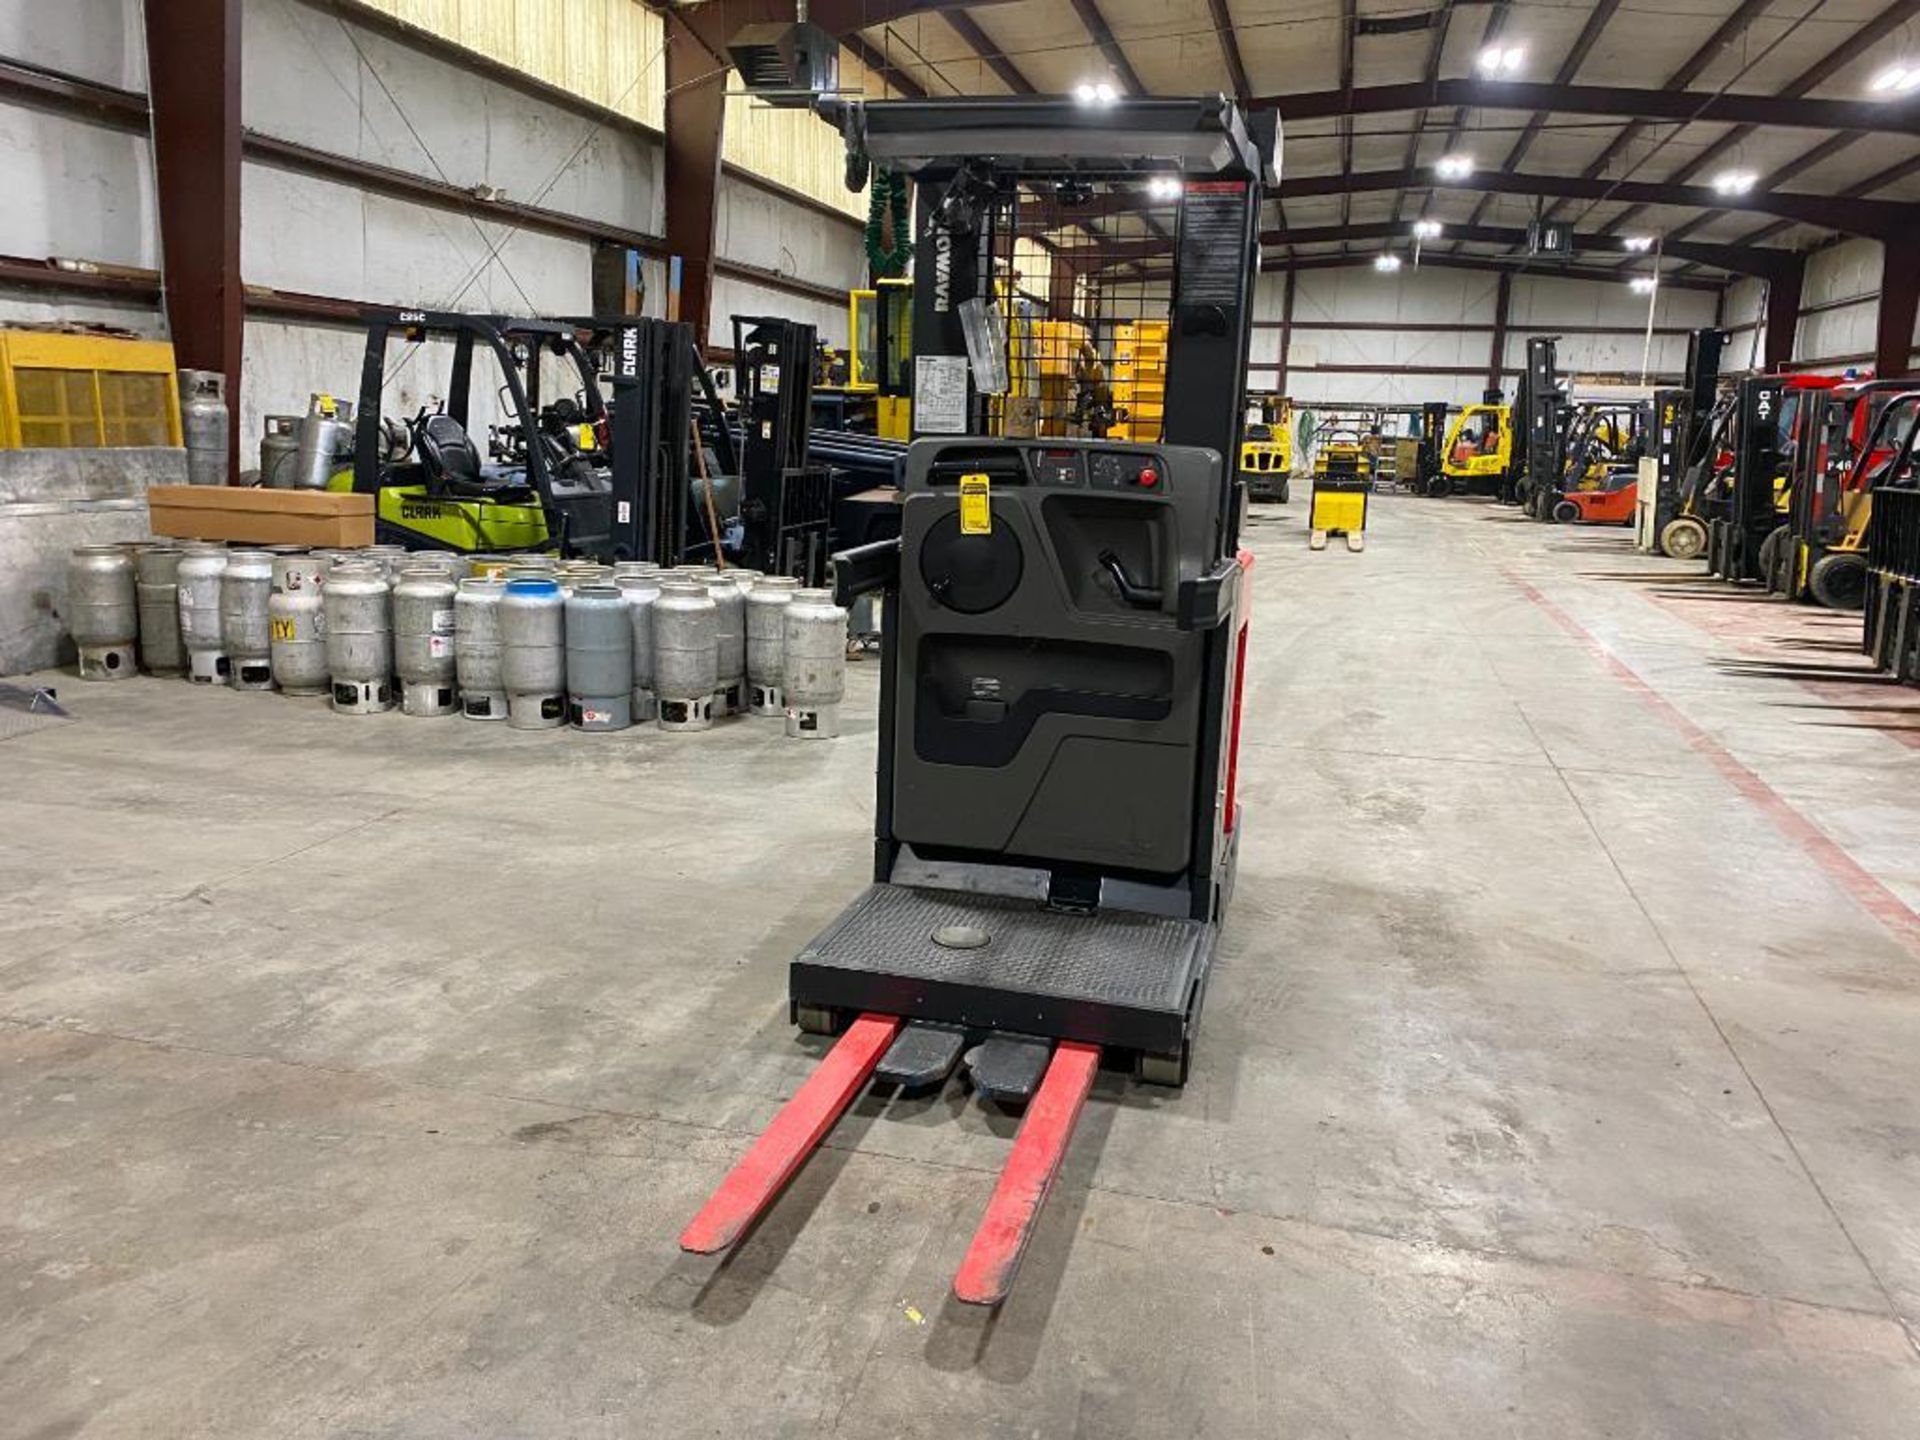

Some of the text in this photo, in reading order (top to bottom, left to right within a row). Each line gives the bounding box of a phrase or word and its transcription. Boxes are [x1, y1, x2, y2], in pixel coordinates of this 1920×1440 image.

[933, 226, 951, 312] RAYMO
[623, 327, 638, 376] CLARK
[1758, 391, 1771, 420] CAT
[402, 505, 441, 520] CLARK
